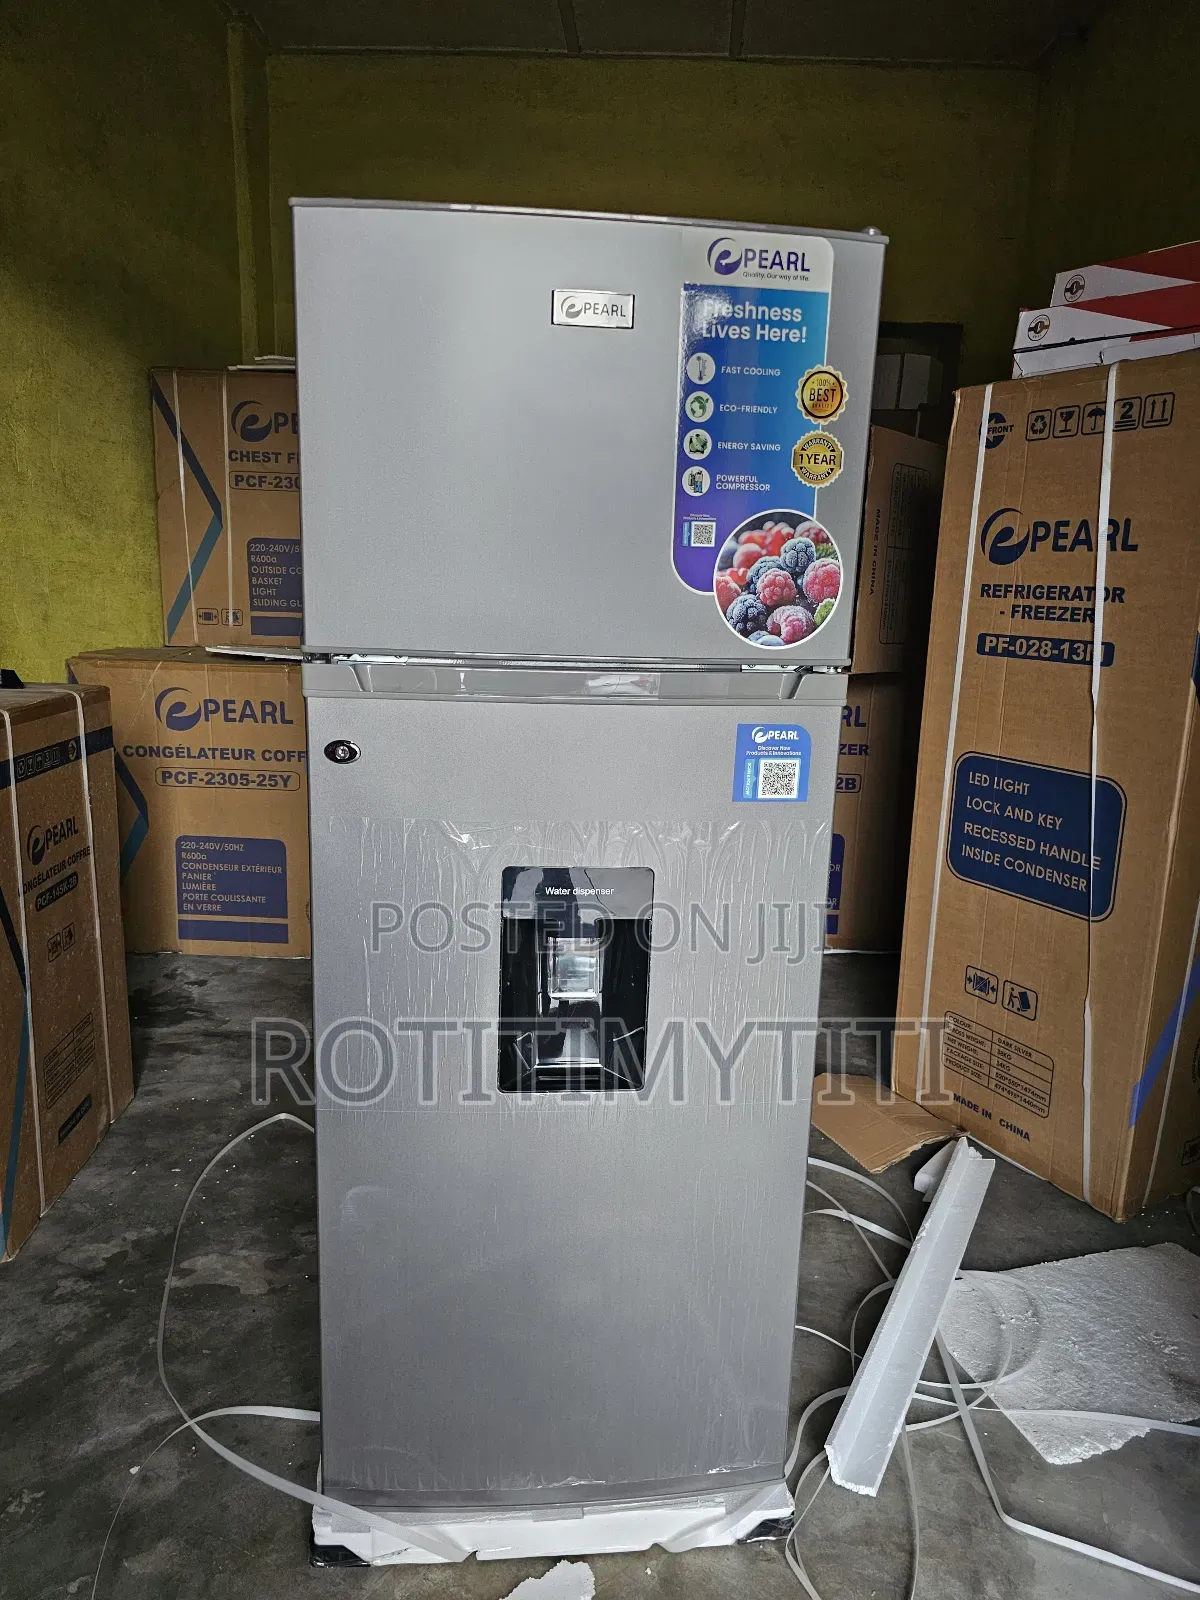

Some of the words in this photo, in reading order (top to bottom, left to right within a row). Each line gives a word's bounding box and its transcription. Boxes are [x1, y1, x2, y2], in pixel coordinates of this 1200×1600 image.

[744, 248, 811, 273] PEARL
[583, 302, 626, 318] PEARL
[704, 300, 803, 322] Freshness
[702, 320, 751, 340] Lives
[756, 324, 807, 344] Here!
[721, 366, 741, 375] FAST
[743, 367, 781, 377] COOLING
[809, 387, 837, 403] BEST
[719, 404, 778, 415] ECO-FRIENDLY
[1119, 401, 1134, 420] 2
[987, 424, 1014, 435] FRONT
[717, 441, 748, 451] ENERGY
[750, 442, 781, 452] SAVING
[802, 438, 834, 452] WARRANTY
[228, 450, 281, 464] CHEST
[799, 454, 804, 464] 1
[805, 454, 837, 466] YEAR
[716, 474, 758, 483] POWERFUL
[801, 467, 833, 481] WARRANTY
[715, 482, 770, 492] COMPRESSOR
[1030, 517, 1138, 553] PEARL
[251, 554, 277, 563] R600a
[251, 565, 287, 575] OUTSIDE
[252, 577, 282, 585] BASKET
[252, 587, 276, 596] LIGHT
[253, 598, 288, 607] SLIDING
[1011, 604, 1095, 624] FREEZER
[203, 698, 294, 725] PEARL
[768, 730, 799, 740] PEARL
[122, 743, 256, 761] CONGÉLATEUR
[161, 770, 293, 789] PCF-2305-25Y
[969, 771, 990, 787] LED
[994, 776, 1030, 797] LIGHT
[966, 796, 1001, 815] LOCK
[1004, 806, 1033, 823] AND
[1037, 812, 1063, 831] KEY
[45, 816, 79, 850] PEARL
[180, 841, 244, 852] 220-240V/50HZ
[963, 821, 1036, 852] RECESSED
[1039, 841, 1102, 870] HANDLE
[181, 852, 207, 860] R600a
[18, 862, 67, 898] ONGÉLATEUR
[67, 846, 91, 867] COFFRE
[181, 862, 239, 872] CONDENSEUR
[241, 864, 283, 874] EXTÉRIEUR
[961, 844, 1001, 867] INSIDE
[1003, 856, 1087, 893] CONDENSER
[181, 872, 212, 881] PANIER
[181, 882, 217, 891] LUMIÈRE
[545, 886, 571, 895] Water
[572, 886, 615, 897] dispenser
[182, 892, 209, 901] PORTE
[210, 893, 266, 903] COULISSANTE
[196, 903, 221, 912] VERRE
[946, 1047, 972, 1063] PACKAGE
[997, 1037, 1013, 1050] DARK
[1013, 1044, 1033, 1059] SILVER
[945, 1057, 970, 1074] PRODUCT
[953, 1093, 980, 1114] MADE
[981, 1108, 993, 1120] IN
[999, 1118, 1031, 1142] CHINA
